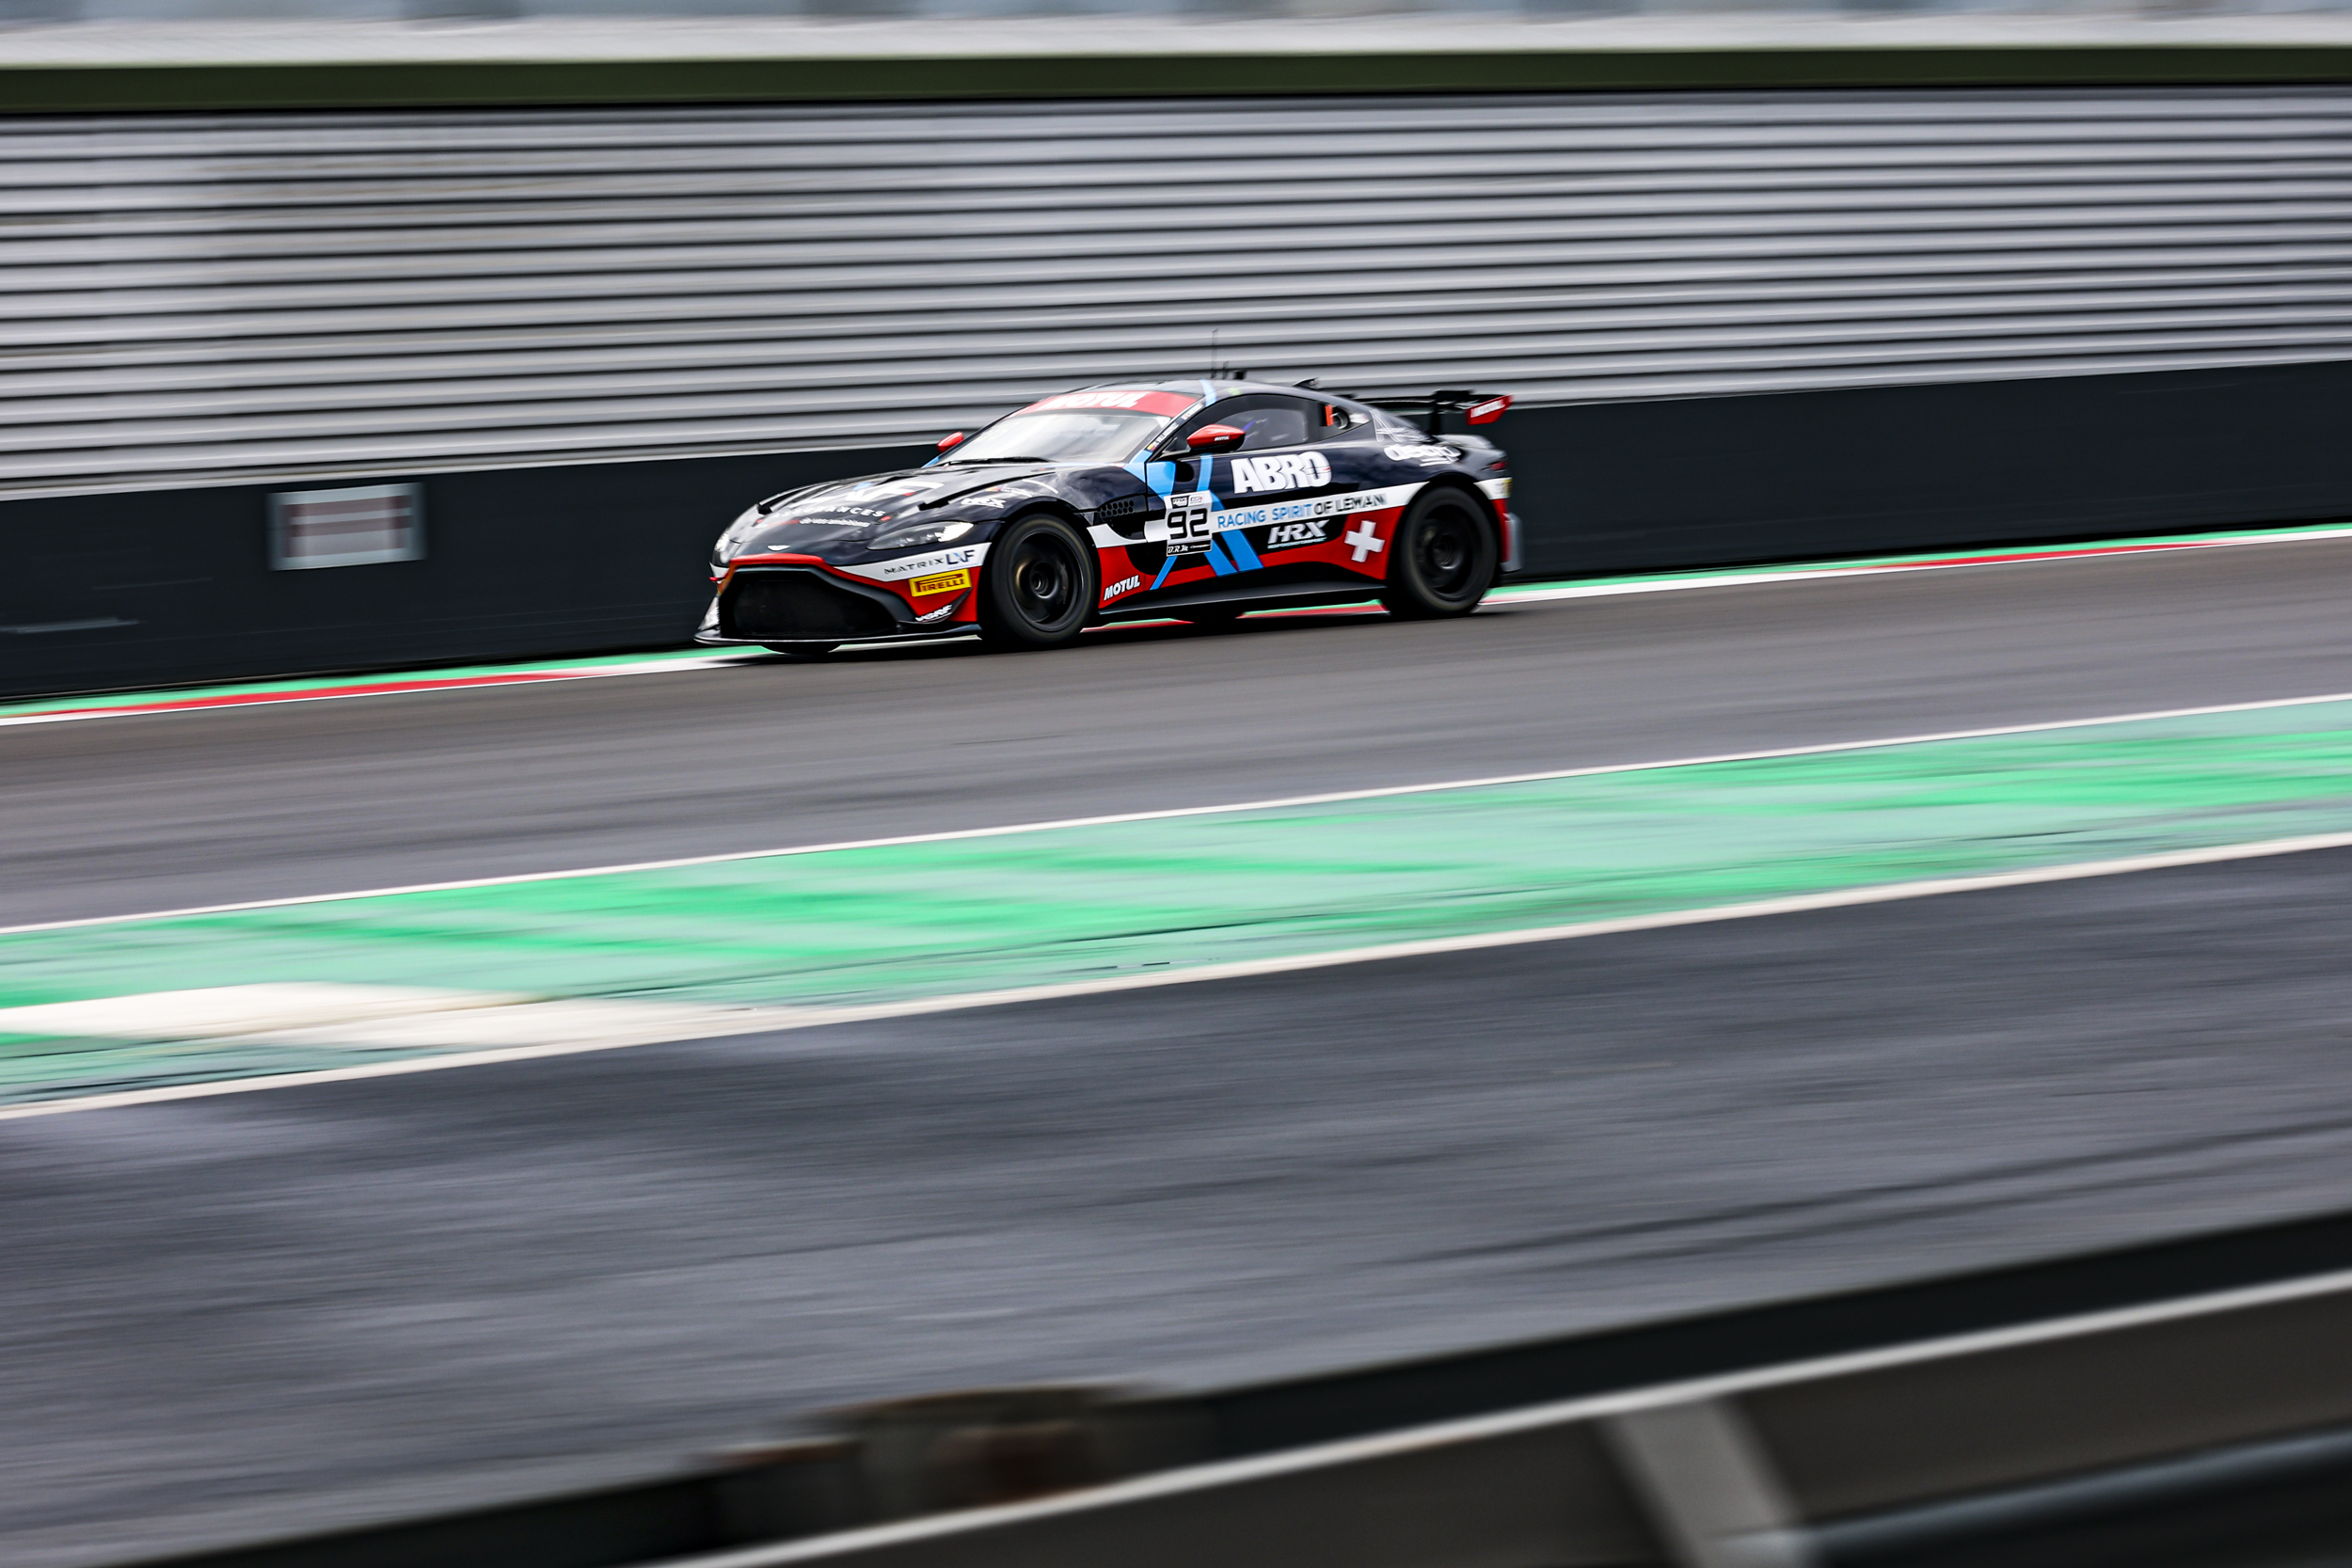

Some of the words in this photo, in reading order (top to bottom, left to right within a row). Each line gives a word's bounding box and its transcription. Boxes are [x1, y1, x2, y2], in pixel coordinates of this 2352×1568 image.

[1036, 391, 1150, 411] MOTUL
[1231, 451, 1332, 495] ABRO
[1168, 508, 1209, 540] 92
[1217, 511, 1266, 529] RACING
[1272, 503, 1312, 521] SPIRIT
[1313, 500, 1333, 515] OF
[1267, 519, 1330, 544] HRX
[884, 558, 945, 575] MATRIX
[914, 573, 965, 593] PIRELLI
[1104, 575, 1140, 601] MOTUL
